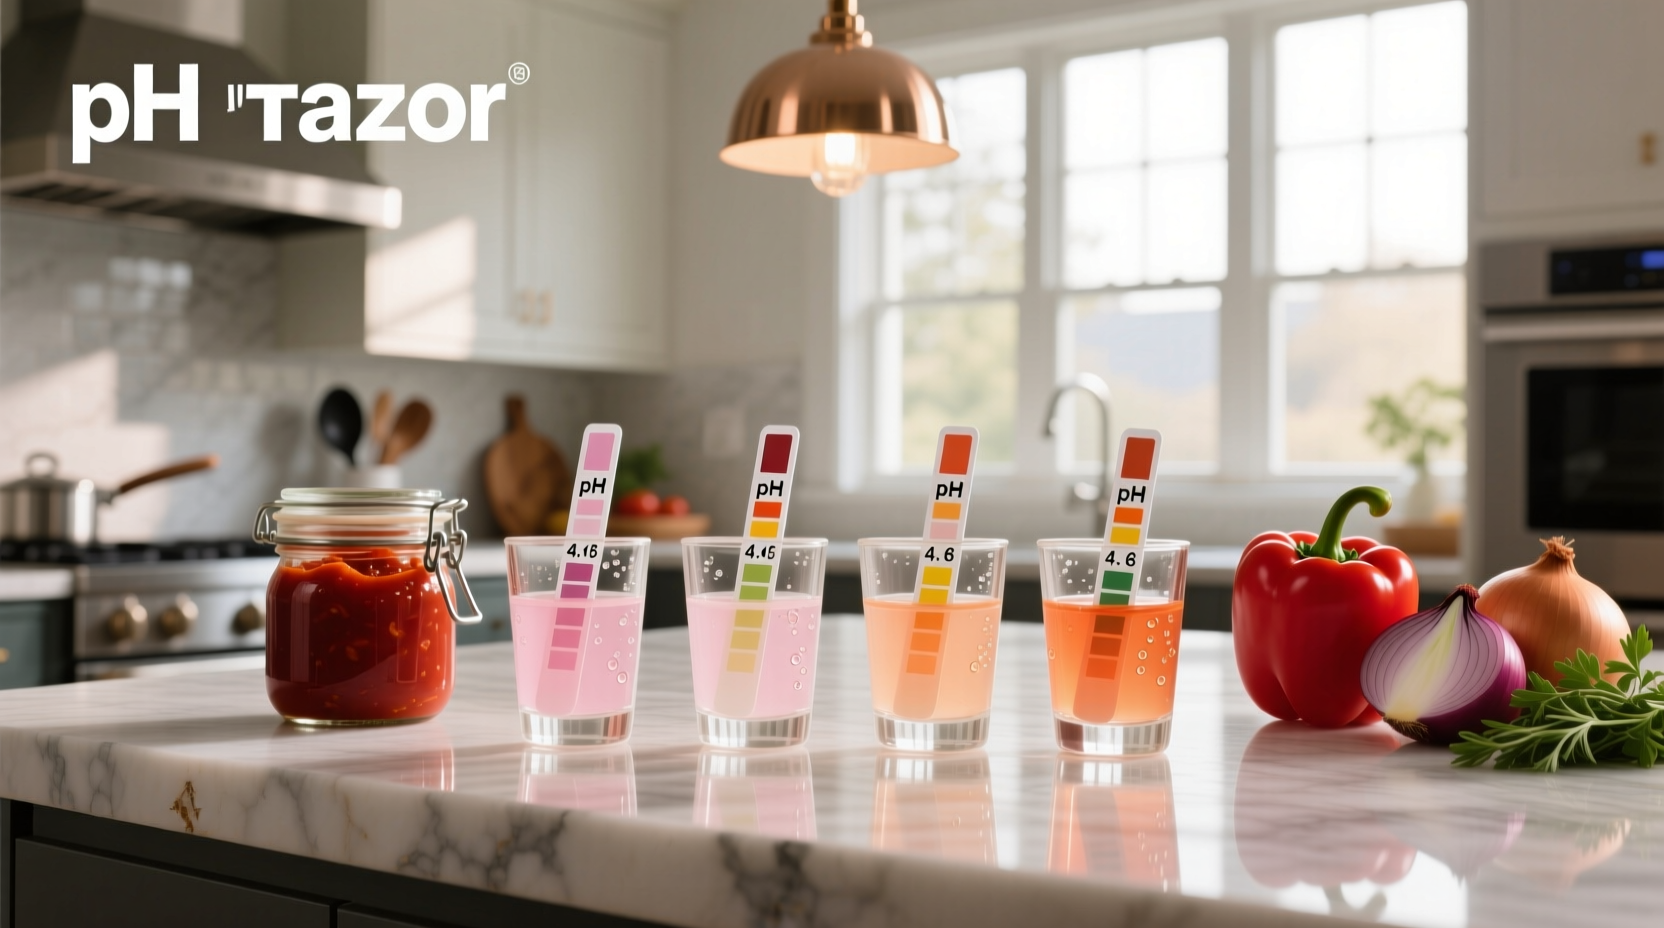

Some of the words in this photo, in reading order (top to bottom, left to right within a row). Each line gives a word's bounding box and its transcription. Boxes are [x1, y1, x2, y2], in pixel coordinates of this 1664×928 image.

[578, 477, 608, 499] pH
[755, 479, 785, 501] pH
[934, 480, 965, 502] pH
[1116, 485, 1148, 507] pH
[924, 546, 956, 562] 4.6
[1104, 550, 1137, 567] 4.6
